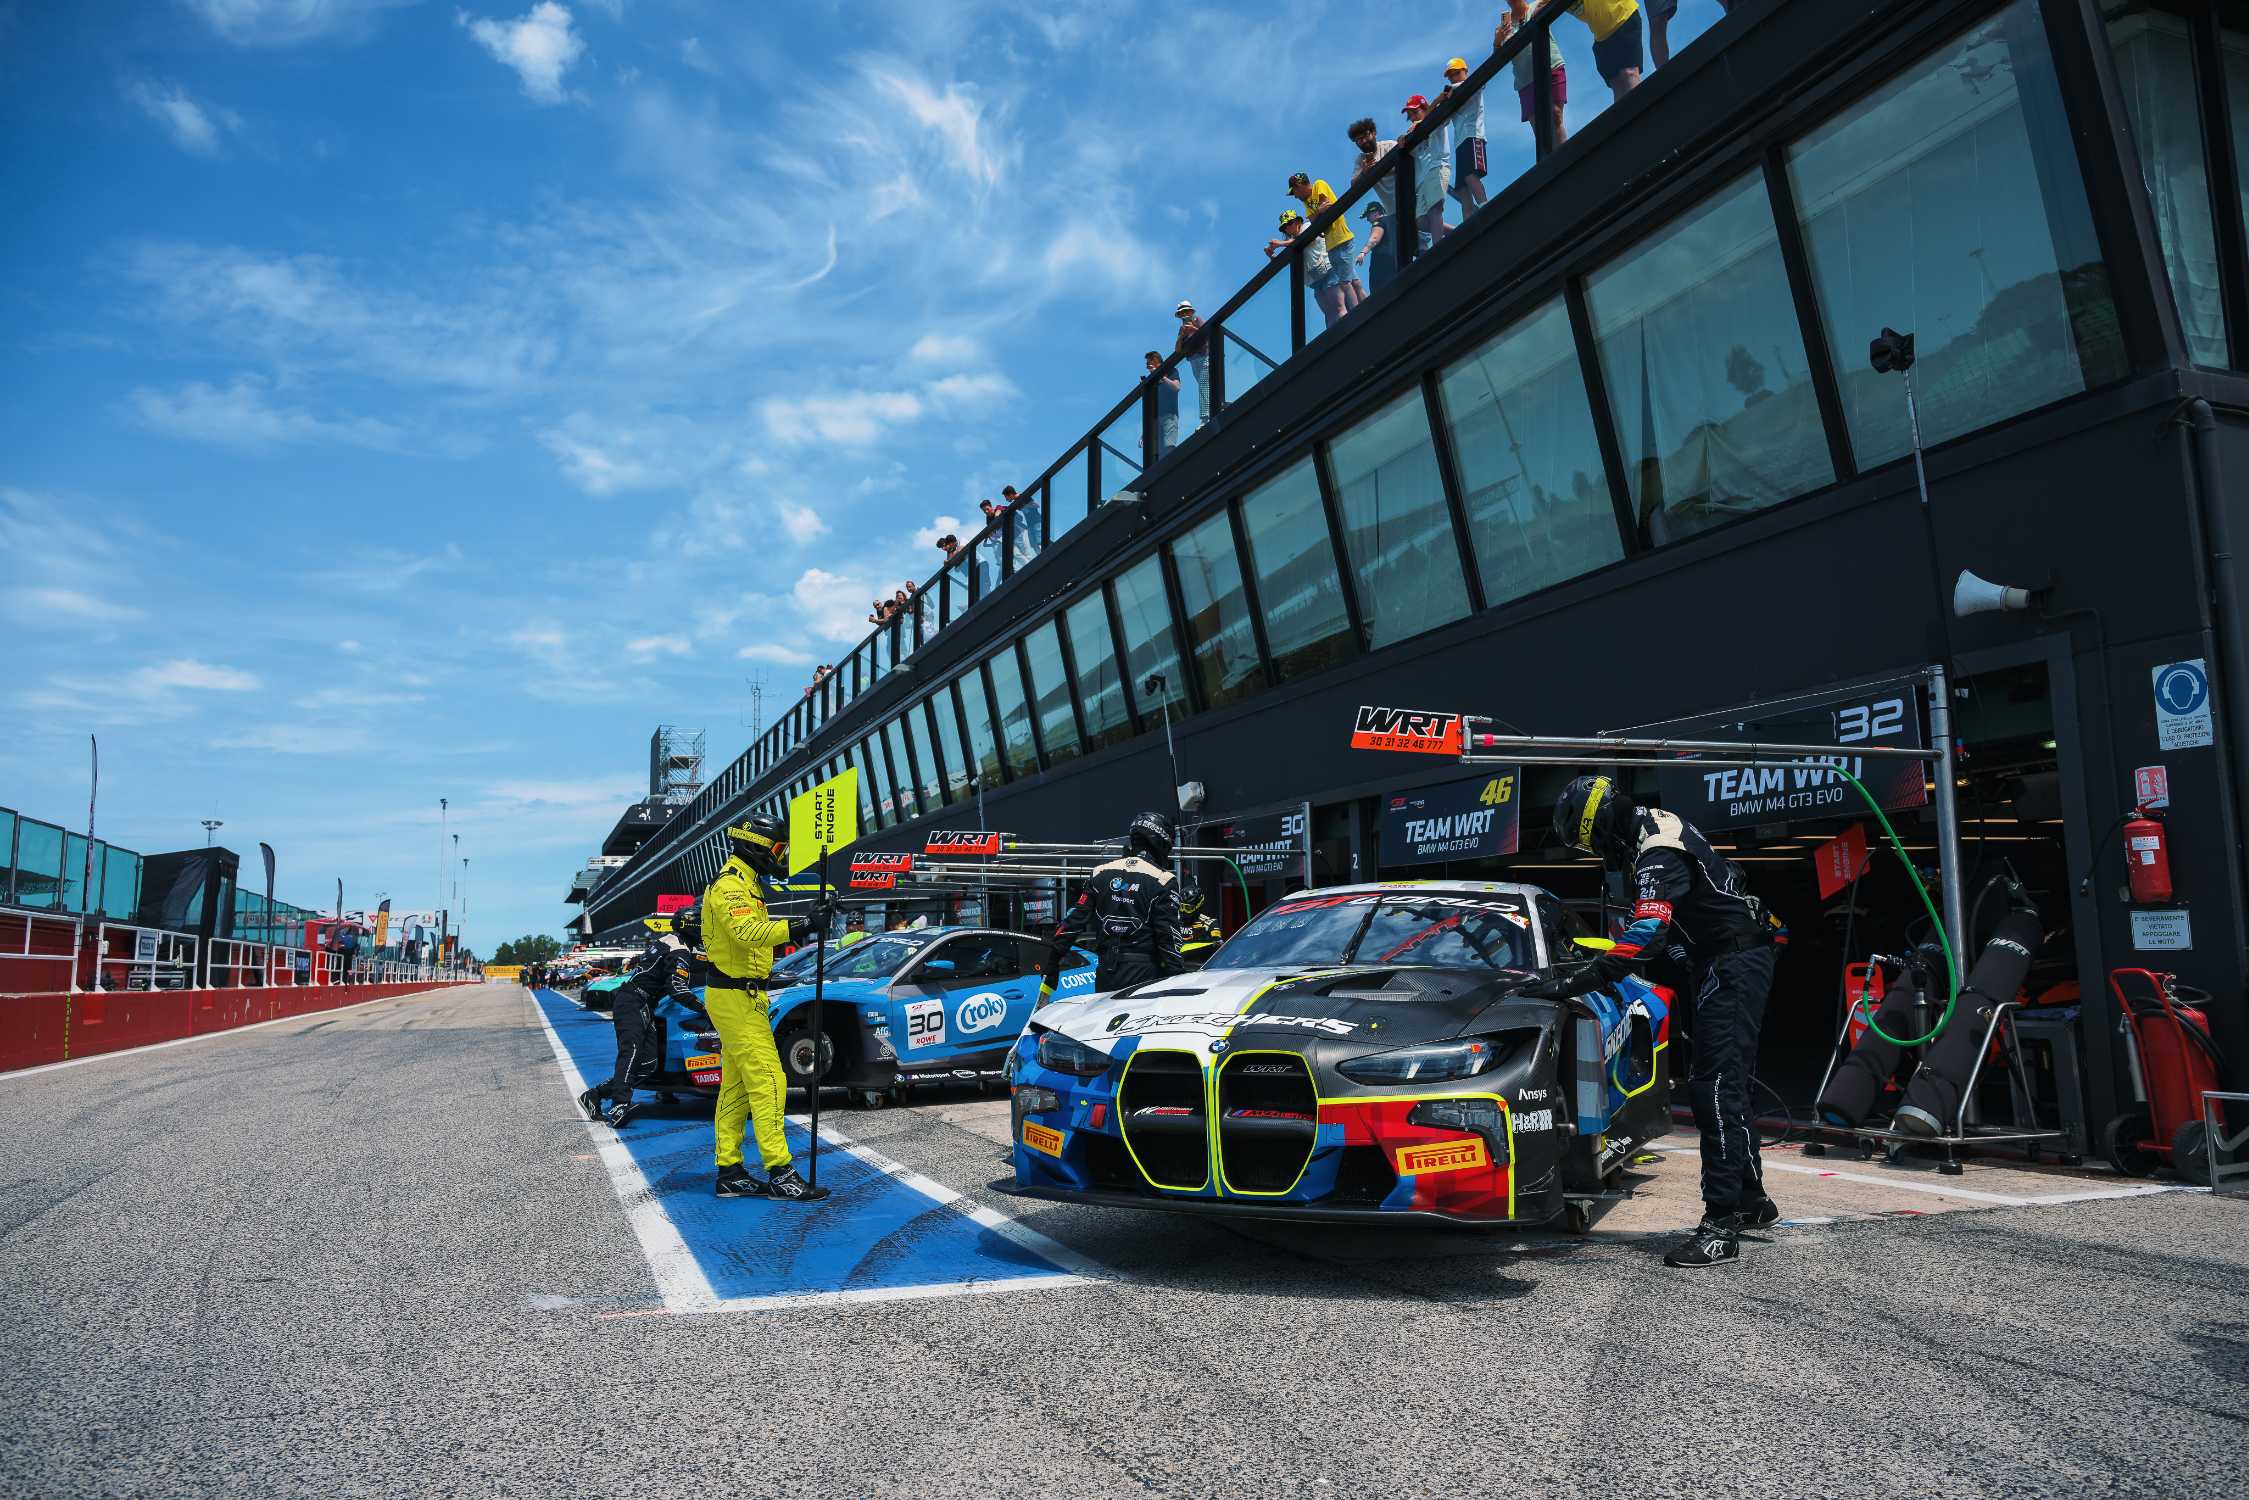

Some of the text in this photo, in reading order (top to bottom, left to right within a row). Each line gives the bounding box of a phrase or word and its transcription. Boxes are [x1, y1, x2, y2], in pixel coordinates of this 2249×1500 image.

[1355, 706, 1459, 739] WRT
[1839, 699, 1904, 743] 32
[1370, 737, 1382, 746] 30
[1385, 738, 1395, 747] 31
[1397, 739, 1410, 748] 32
[1427, 741, 1444, 750] 777
[1480, 776, 1513, 806] 46
[1703, 769, 1785, 802] TEAM
[1730, 788, 1843, 817] BMW M4 GT3 EVO
[827, 789, 835, 843] ENGINE
[1281, 814, 1304, 837] 30
[1405, 809, 1495, 843] TEAM WRT
[927, 831, 997, 846] WRT
[1417, 837, 1479, 855] BMW M4 GT3 EVO
[852, 853, 909, 865] WRT
[1352, 853, 1359, 869] 2
[852, 871, 893, 882] WRT
[1061, 971, 1096, 989] CONT
[909, 1011, 944, 1036] 30
[961, 998, 1004, 1029] Croky
[916, 1035, 937, 1045] ROWE
[687, 1056, 717, 1068] PIRELLI
[1243, 1064, 1293, 1073] WRT
[695, 1073, 720, 1084] TAROS
[1518, 1088, 1547, 1101] Ansys
[1026, 1126, 1060, 1152] PIRELLI
[1404, 1145, 1477, 1170] PIRELLI
